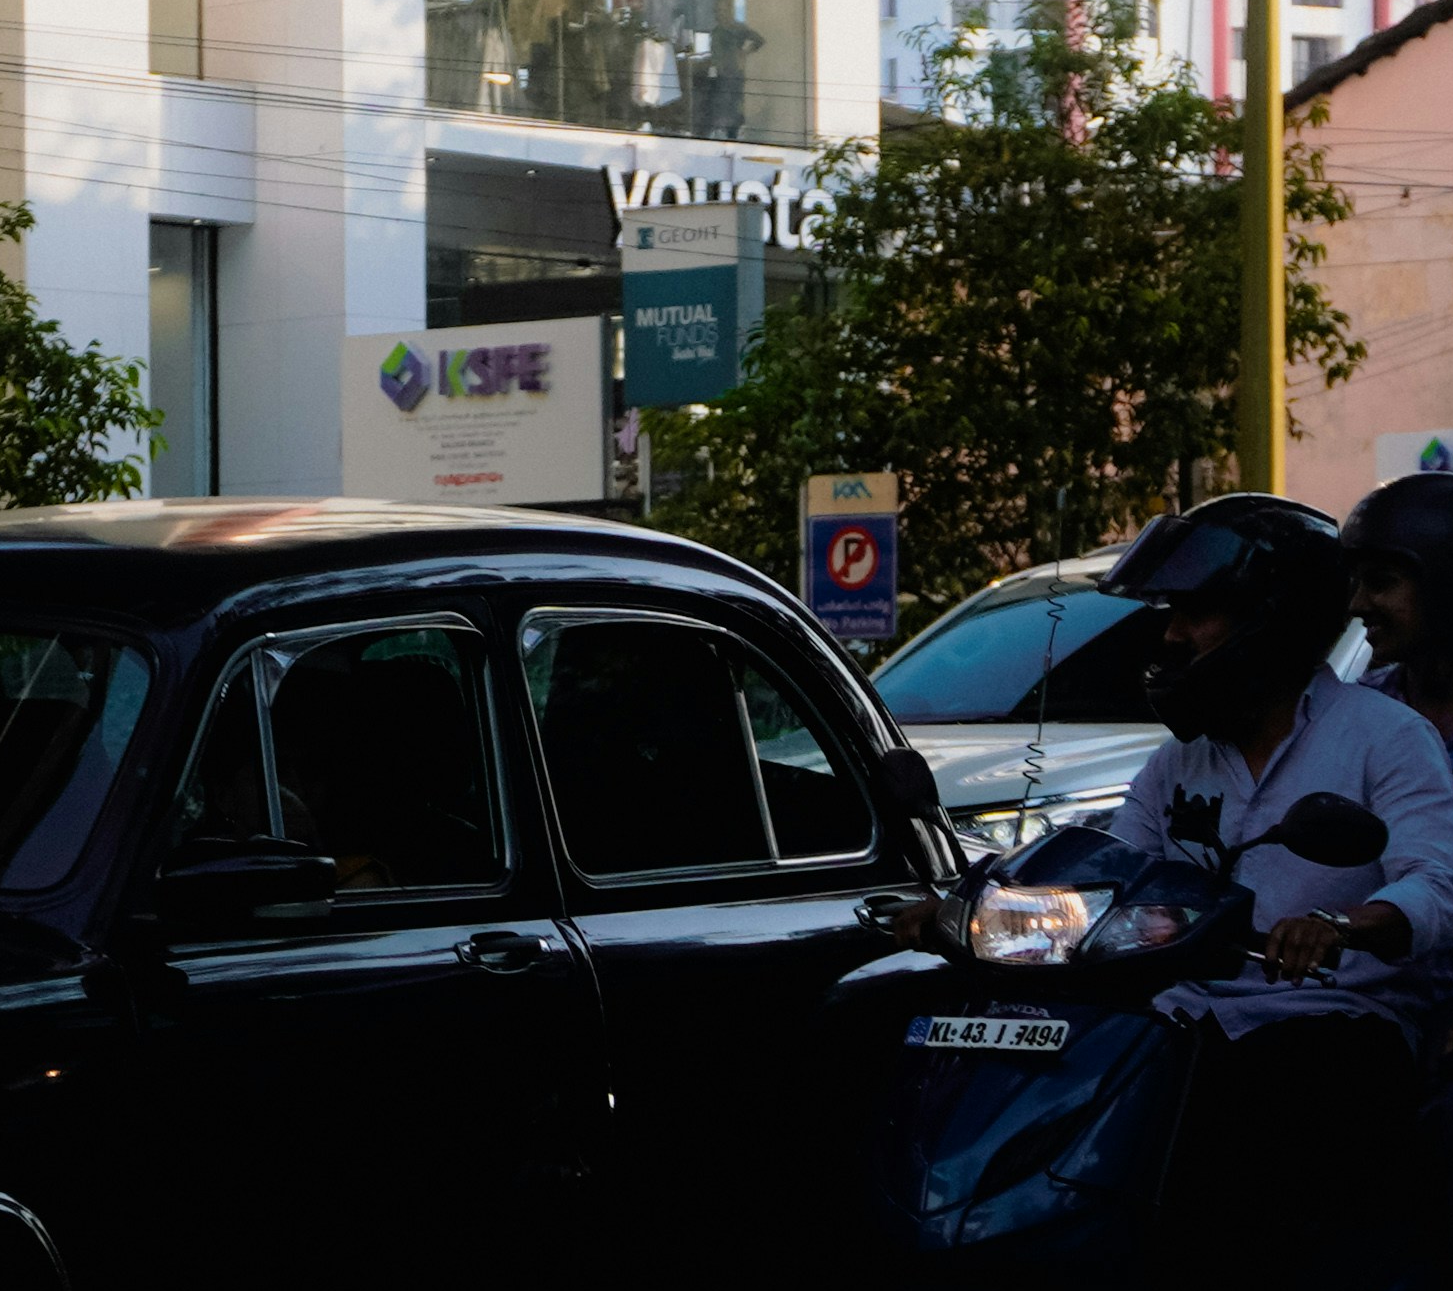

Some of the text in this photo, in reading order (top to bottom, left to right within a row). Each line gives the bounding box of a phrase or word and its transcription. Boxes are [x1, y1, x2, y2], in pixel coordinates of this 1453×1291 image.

[658, 224, 721, 245] GEOJIT
[635, 303, 718, 327] MUTUAL
[657, 324, 720, 347] FUNDS
[438, 342, 553, 399] KSFE
